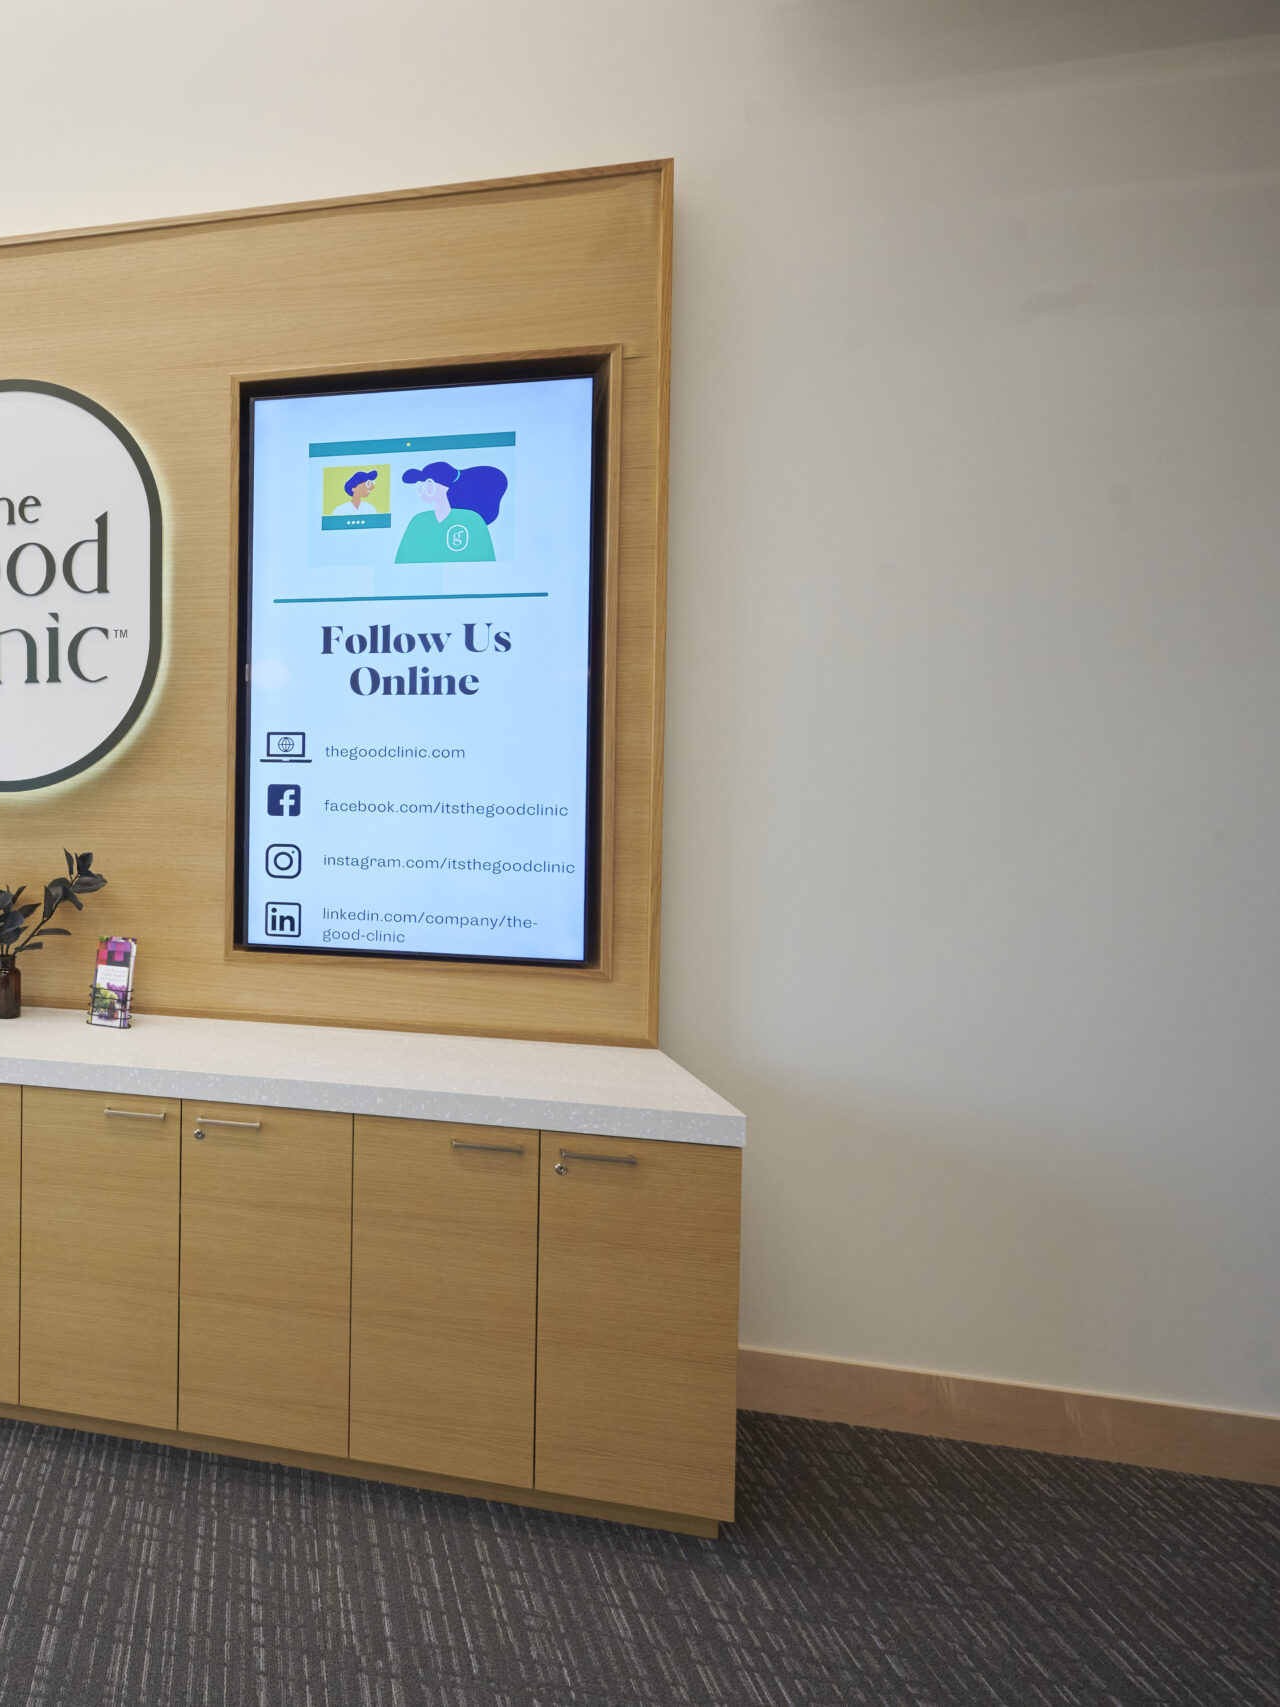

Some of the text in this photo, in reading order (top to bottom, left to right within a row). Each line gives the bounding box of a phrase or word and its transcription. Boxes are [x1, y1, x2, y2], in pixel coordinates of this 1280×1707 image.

[320, 622, 512, 655] Follow Us
[349, 665, 480, 696] Online
[324, 745, 466, 761] thegoodclinic.com
[323, 799, 569, 818] facebook.com/itsthegoodclinic
[322, 854, 576, 875] instagram.com/itsthegoodclinic
[322, 908, 539, 930] linkedin.com/company/the-
[321, 928, 406, 944] good-clinic
